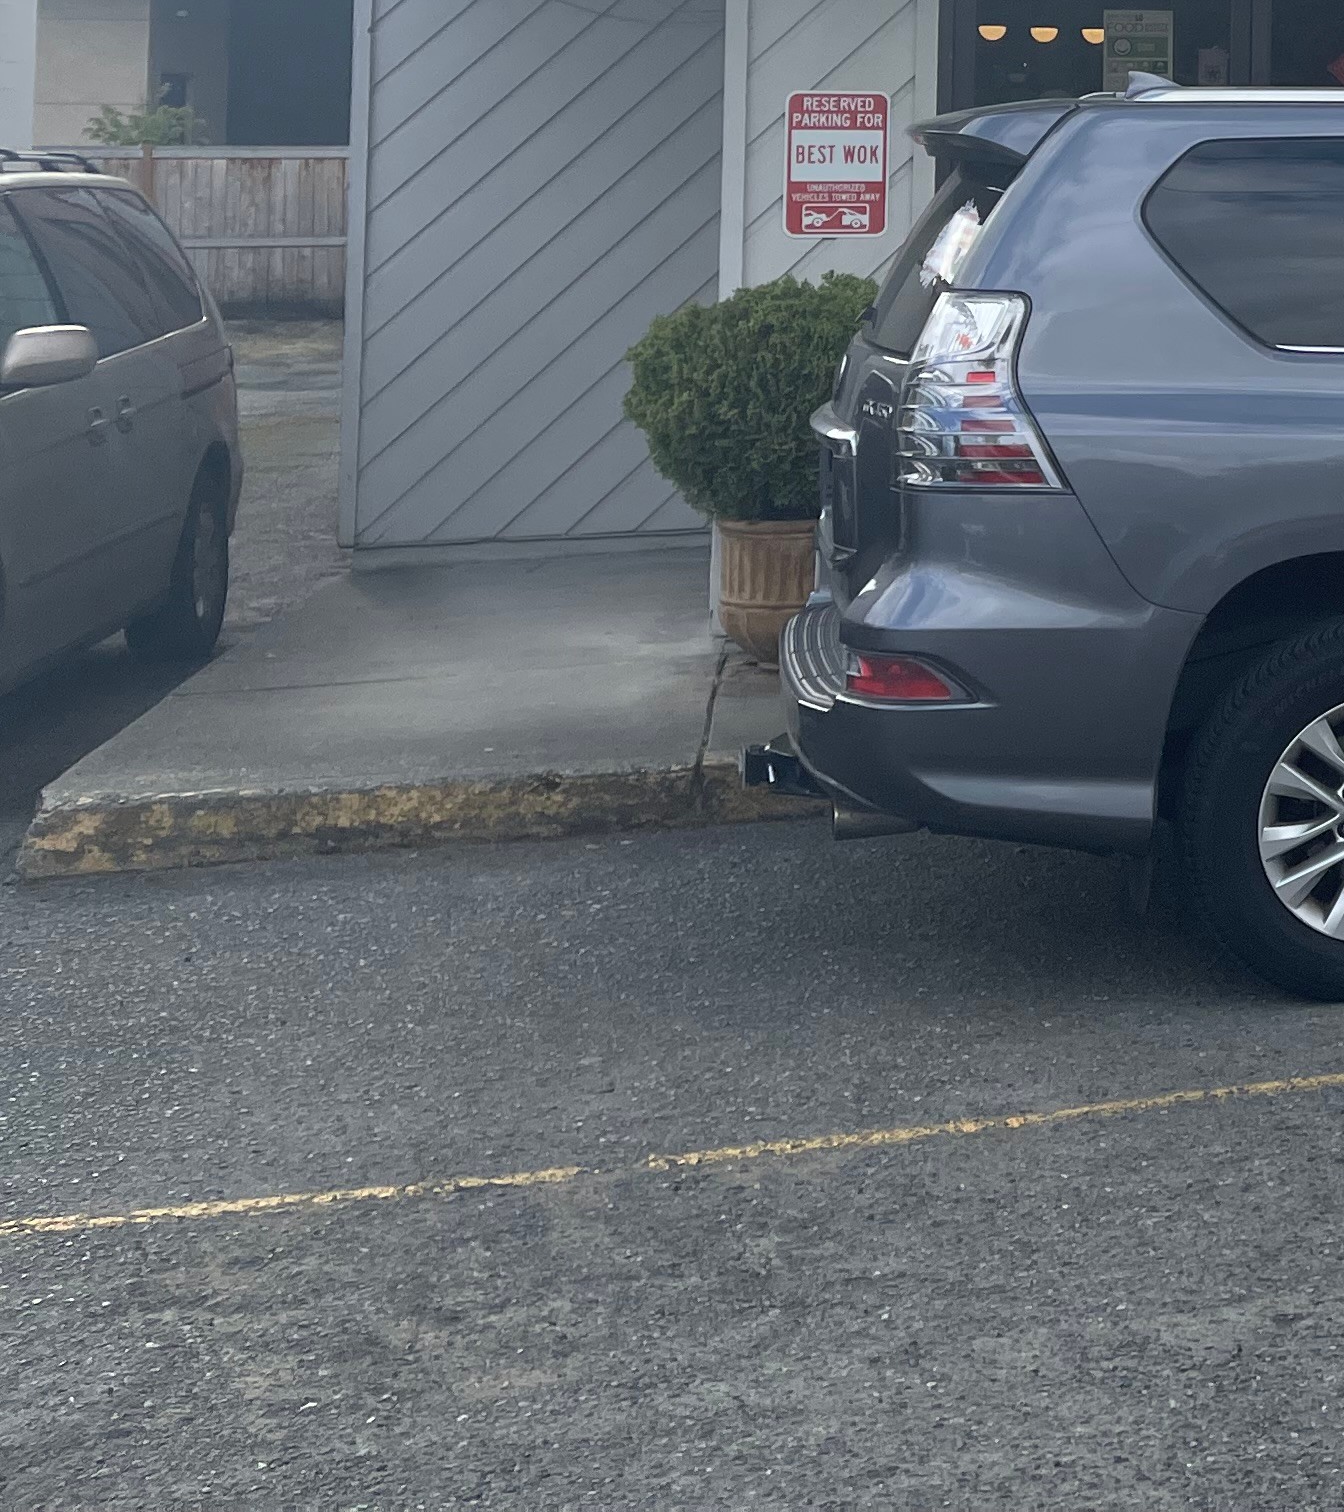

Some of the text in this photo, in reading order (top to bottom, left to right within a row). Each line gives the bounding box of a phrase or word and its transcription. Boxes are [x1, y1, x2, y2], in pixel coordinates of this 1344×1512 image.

[803, 96, 875, 111] RESERVED
[792, 113, 883, 128] PARKING FOR
[795, 145, 880, 164] BEST WOK
[860, 193, 880, 202] AWAY
